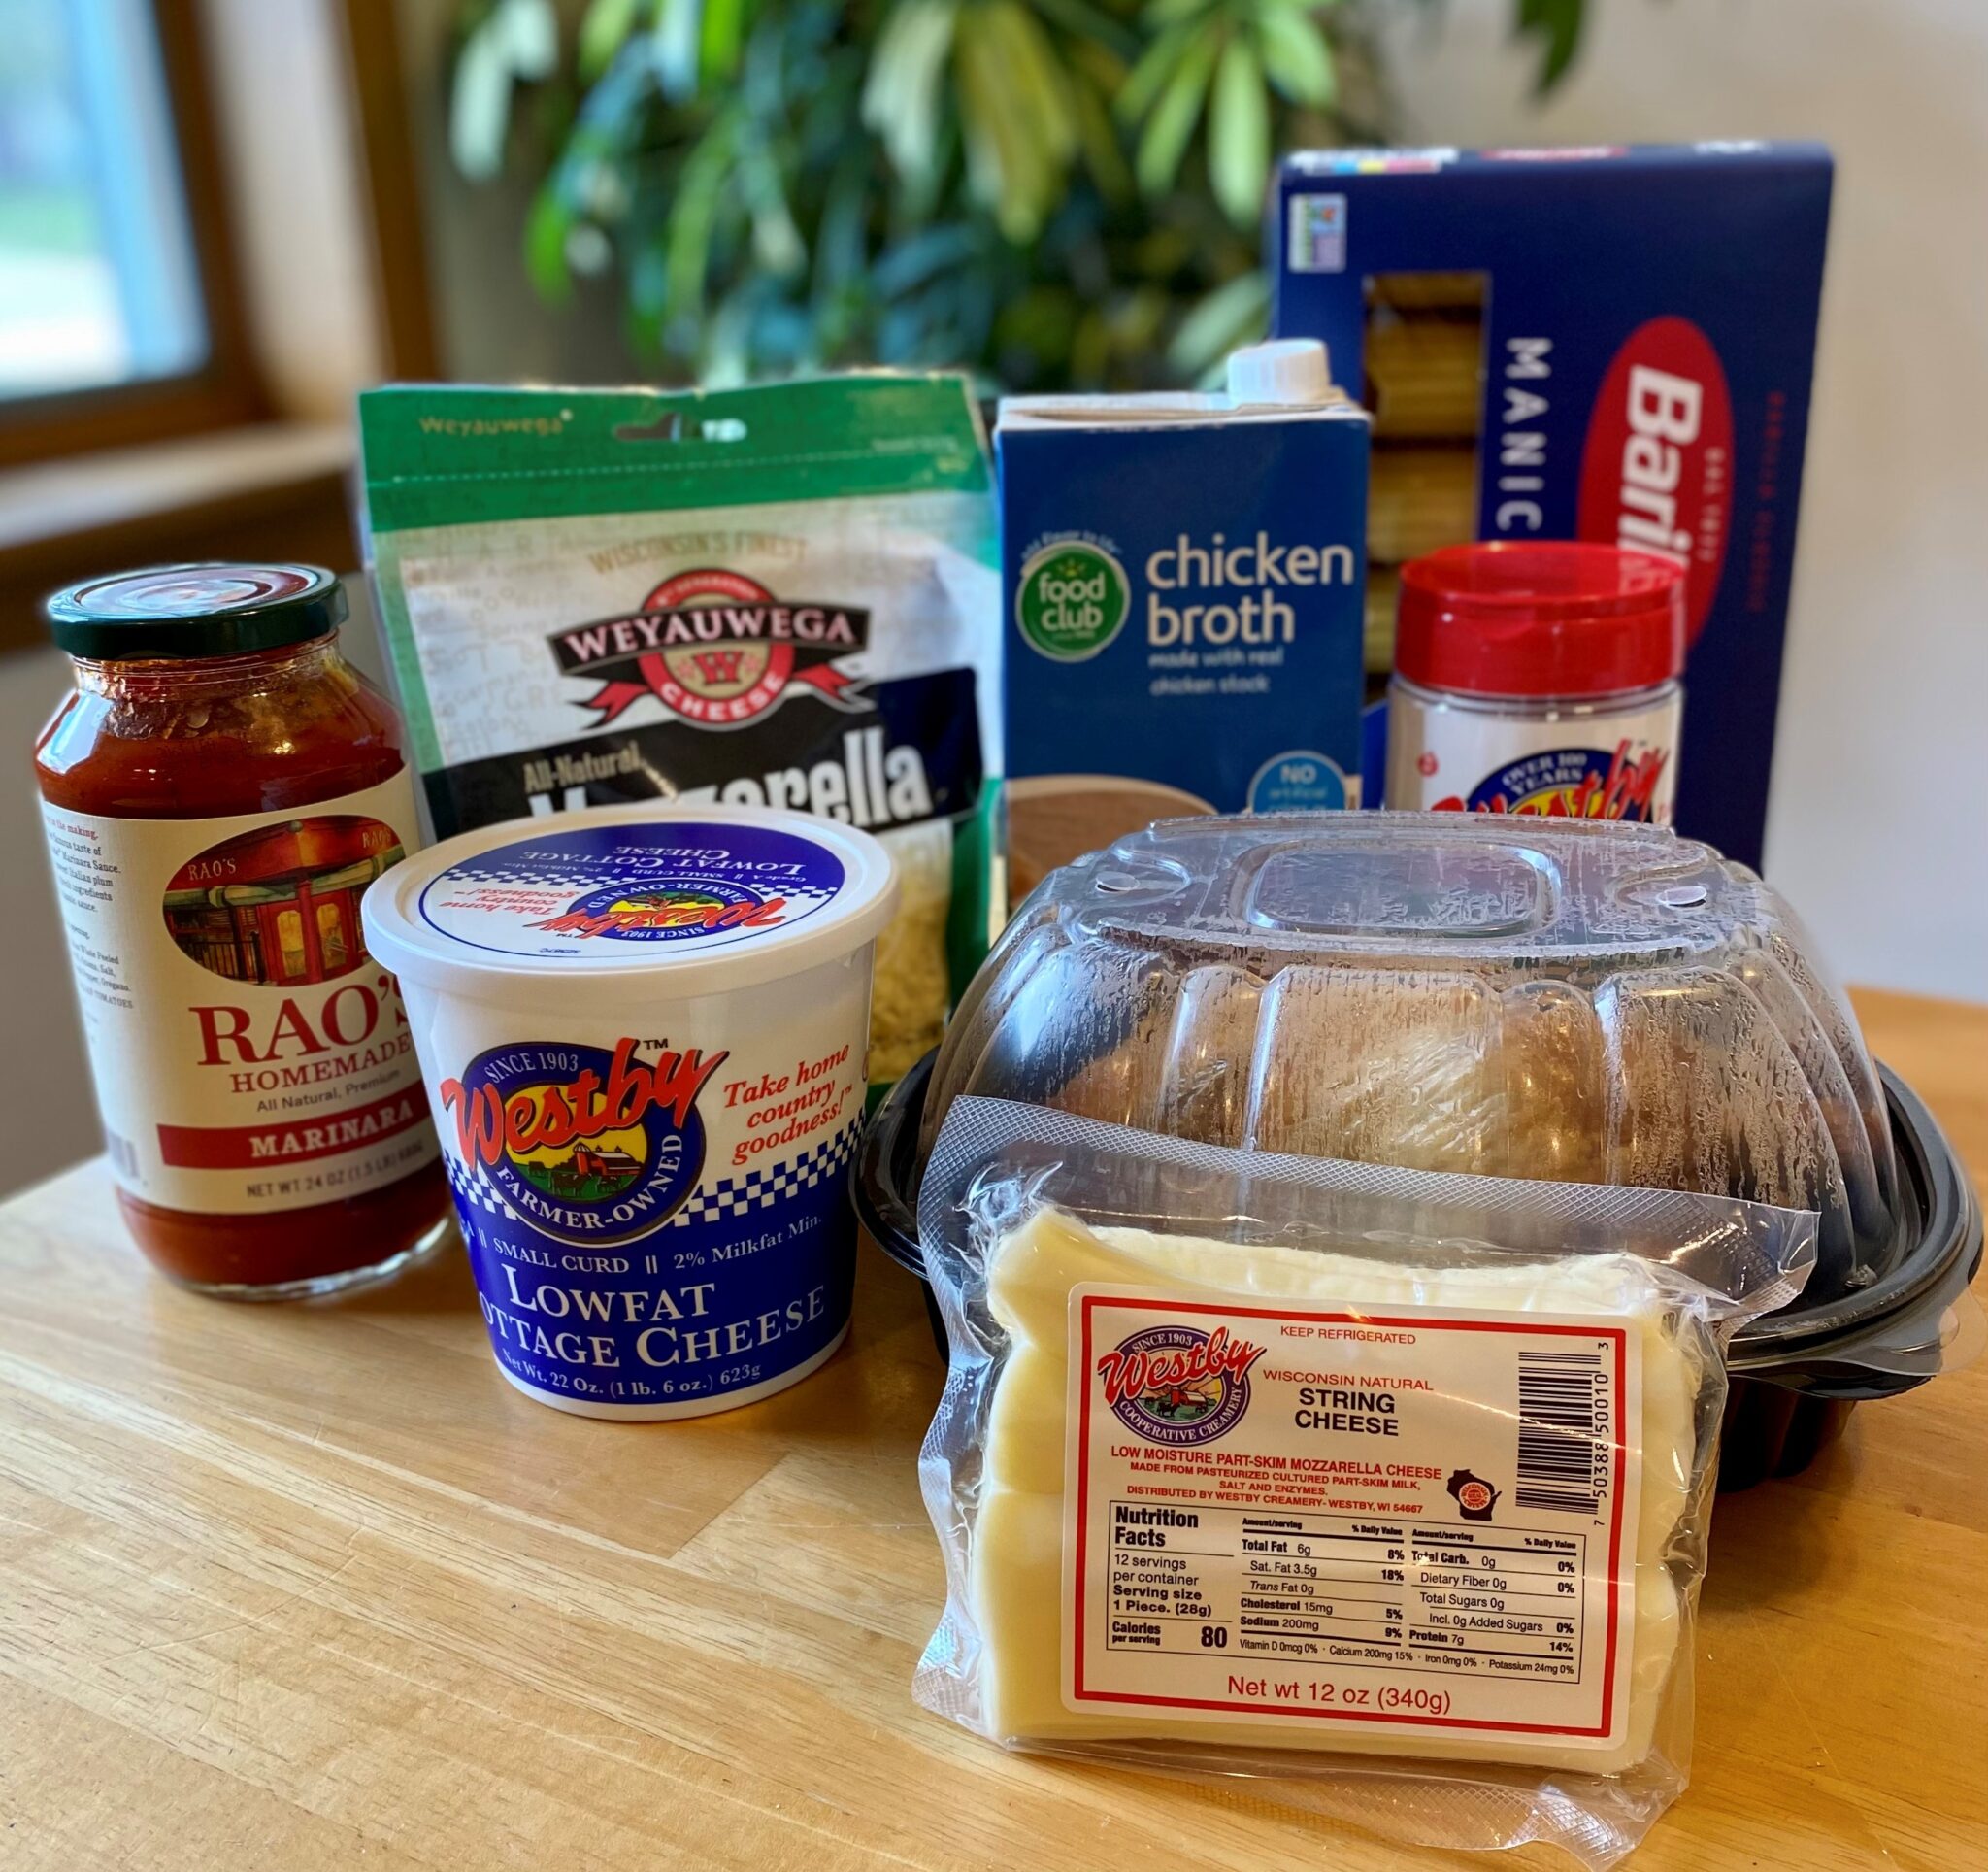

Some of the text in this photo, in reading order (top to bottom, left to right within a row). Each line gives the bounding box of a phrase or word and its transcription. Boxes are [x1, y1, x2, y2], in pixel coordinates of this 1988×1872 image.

[1146, 531, 1353, 589] chicken
[1039, 571, 1106, 603] food
[1041, 601, 1103, 631] club
[1148, 588, 1295, 646] broth
[564, 608, 857, 664] WEYAUWEGA
[1148, 645, 1284, 668] made with real
[660, 672, 784, 721] CHEESE
[1149, 673, 1270, 696] chicken stock
[523, 742, 641, 793] All-Natural
[1280, 764, 1316, 785] NO
[1503, 755, 1554, 786] OVER
[1509, 768, 1582, 795] YEARS
[93, 847, 102, 856] of
[93, 875, 115, 887] plum
[188, 857, 237, 881] RAO'S
[440, 900, 556, 916] Take home
[476, 894, 558, 906] country
[587, 883, 749, 909] FARMER-OWNED
[522, 897, 787, 940] Westby
[230, 1032, 411, 1093] HOMEMADE
[484, 1052, 579, 1084] SINCE 1903
[723, 1044, 849, 1109] Take home
[257, 1095, 277, 1113] All
[282, 1087, 342, 1109] Natural,
[440, 1036, 730, 1170] Westby
[746, 1079, 836, 1129] country
[248, 1099, 414, 1158] MARINARA
[247, 1183, 273, 1198] NET
[280, 1179, 300, 1194] WT
[306, 1175, 322, 1190] 24
[496, 1133, 683, 1230] FARMER-OWNED
[493, 1214, 823, 1274] SMALL CURD 2% Milkfat Min.
[1131, 1332, 1193, 1353] SINCE 1903
[1280, 1325, 1417, 1345] KEEP REFRIGERATED
[503, 1347, 762, 1400] Net Wt. 22 Oz. (1 lb. 6 oz.) 623g
[1097, 1326, 1268, 1407] Westby
[1263, 1369, 1435, 1391] WISCONSIN NATURAL
[1119, 1387, 1242, 1442] COOPERATIVE CREAMERY
[1299, 1387, 1396, 1415] STRING
[1594, 1373, 1610, 1434] 50010
[1294, 1409, 1399, 1437] CHEESE
[1111, 1445, 1442, 1480] LOW MOISTURE PART-SKIM MOZZARELLA CHEESE
[1130, 1461, 1421, 1491] MADE FROM PASTEURIZED CULTURED PART-SKIM MILK,
[1127, 1485, 1197, 1499] DISTRIBUTED
[1199, 1489, 1213, 1499] BY
[1215, 1490, 1261, 1503] WESTBY
[1328, 1499, 1376, 1512] WESTBY,
[1377, 1502, 1391, 1512] WI
[1393, 1503, 1423, 1514] 54667
[1219, 1480, 1328, 1496] SALT AND ENZYMES.
[1115, 1505, 1200, 1528] Nutrition
[1115, 1525, 1167, 1548] Facts
[1242, 1539, 1406, 1560] Total Fat 6g 8%
[1114, 1553, 1187, 1572] 12 servings
[1250, 1559, 1405, 1582] Sat. Fat 3.5g 18%
[1113, 1571, 1200, 1586] per container
[1250, 1580, 1315, 1596] Trans Fat 0g
[1113, 1584, 1203, 1601] Serving size
[1113, 1599, 1212, 1618] 1 Piece. (28g)
[1241, 1597, 1404, 1620] Cholesterol 15mg 5%
[1112, 1620, 1228, 1649] Calories 80
[1240, 1616, 1280, 1627] Sodium
[1282, 1619, 1320, 1632] 200mg
[1112, 1634, 1161, 1647] per serving
[1408, 1629, 1574, 1653] Protein 7g 14%
[1228, 1675, 1452, 1716] Net wt 12 oz (340g)
